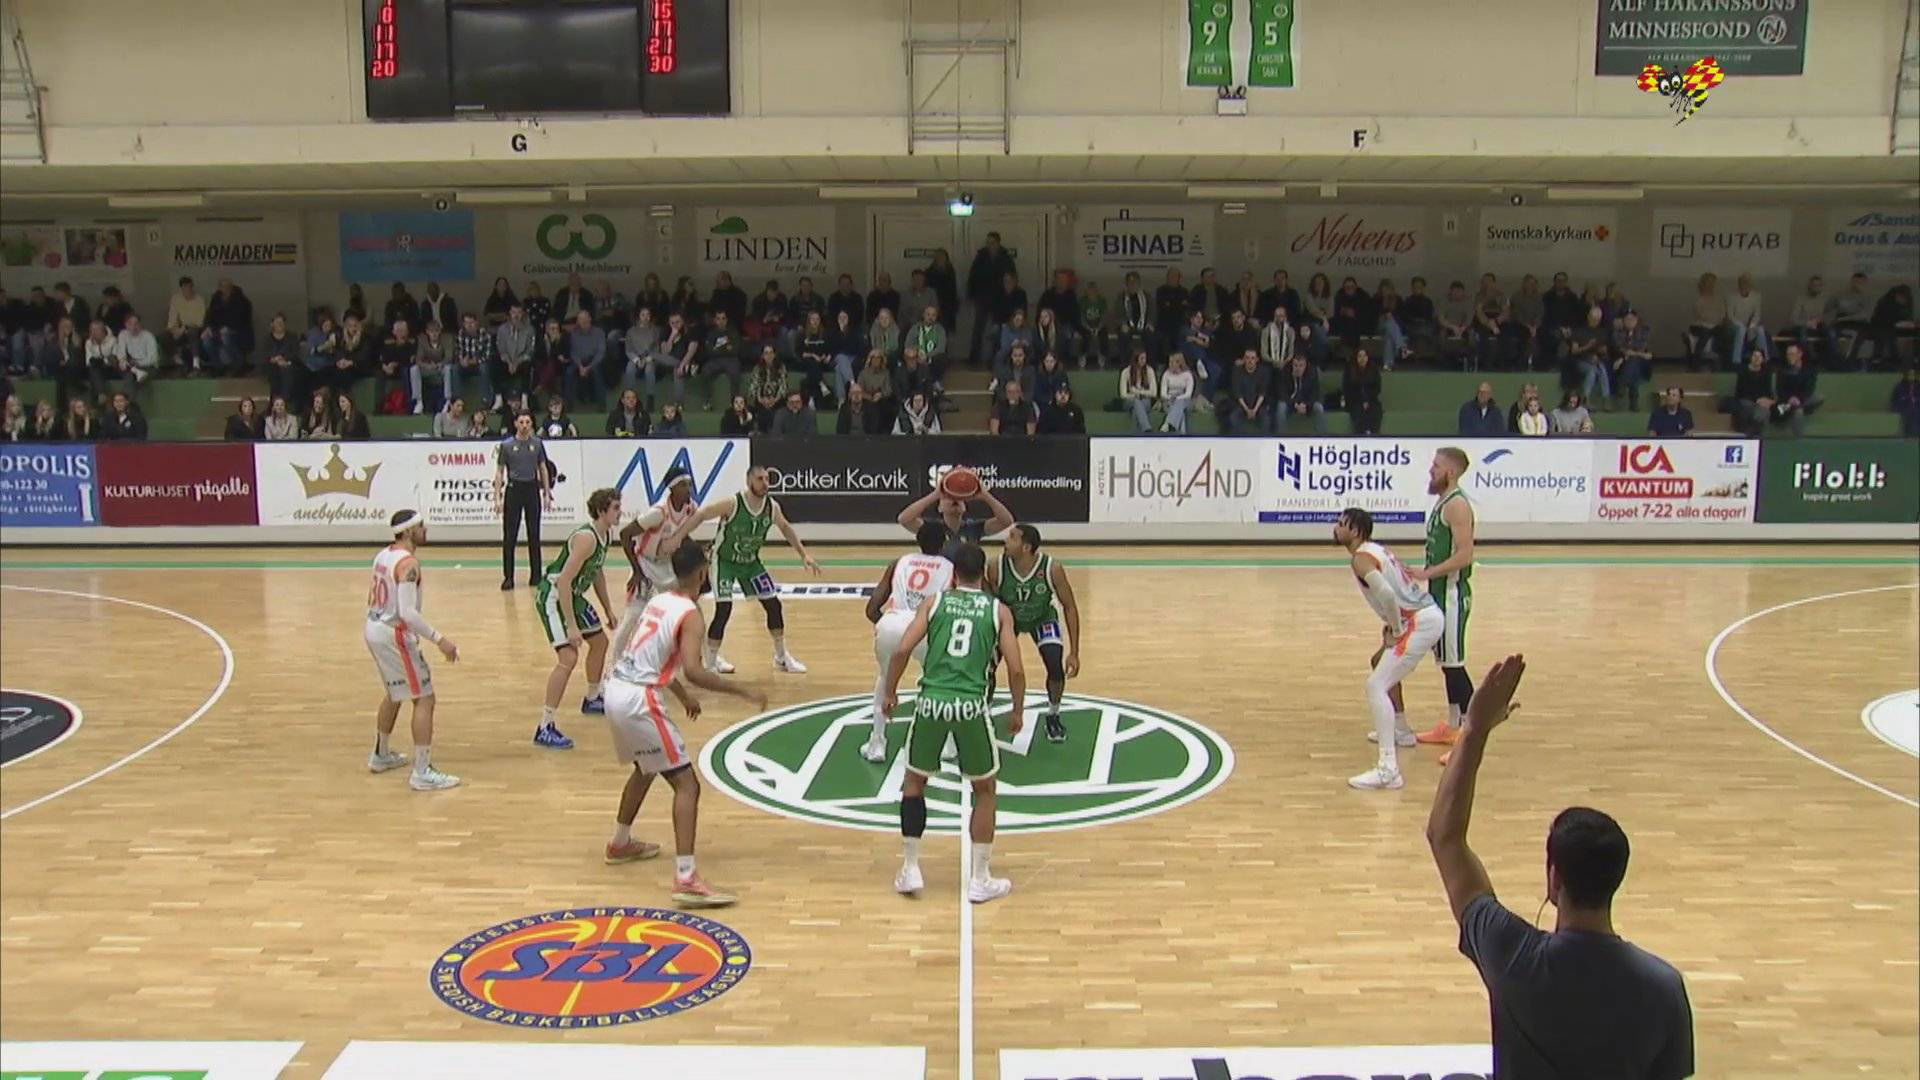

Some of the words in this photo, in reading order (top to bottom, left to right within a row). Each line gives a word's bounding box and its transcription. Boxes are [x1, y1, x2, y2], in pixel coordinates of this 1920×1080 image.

[376, 25, 394, 42] 11
[654, 20, 672, 37] 17
[1203, 21, 1218, 45] 9
[1264, 21, 1278, 46] 5
[1609, 20, 1751, 39] MINNESFOND
[376, 43, 394, 60] 17
[650, 38, 672, 55] 21
[372, 60, 395, 77] 20
[650, 55, 673, 73] 30
[511, 134, 527, 152] G
[1353, 129, 1367, 148] F
[1102, 234, 1185, 255] BINAB
[1290, 212, 1418, 265] Nyhems
[1486, 225, 1543, 241] Svenska
[1545, 225, 1593, 243] kyrkan
[1701, 233, 1781, 250] RUTAB
[174, 244, 274, 261] KANONADEN
[704, 236, 828, 261] LINDEN
[440, 452, 486, 466] YAMAHA
[1308, 444, 1411, 470] Höglands
[1619, 444, 1675, 474] ICA
[766, 467, 840, 494] Optiker
[846, 467, 908, 489] Karvik
[1108, 449, 1252, 507] HÖGLAND
[1308, 470, 1393, 496] Logistik
[1475, 471, 1586, 493] Nömmeberg
[1793, 462, 1885, 489] Flokk
[104, 485, 191, 498] KULTURHUSET
[194, 476, 250, 502] pigalle
[1603, 480, 1689, 495] KVANTUM
[292, 502, 386, 525] anebybuss.se
[1598, 502, 1639, 521] Öppet
[1642, 503, 1673, 518] 7-22
[1676, 506, 1700, 519] alla
[1703, 505, 1747, 522] dagar!
[908, 569, 930, 590] 0
[1015, 586, 1032, 602] 17
[947, 617, 974, 657] 8
[459, 909, 577, 952] SVENSKA
[594, 906, 746, 956] BASKETLIGAN
[474, 940, 704, 983] SBL
[437, 965, 487, 1014] SWEDISH
[485, 1005, 669, 1028] BASKETBALL
[673, 967, 744, 1009] LEAGUE
